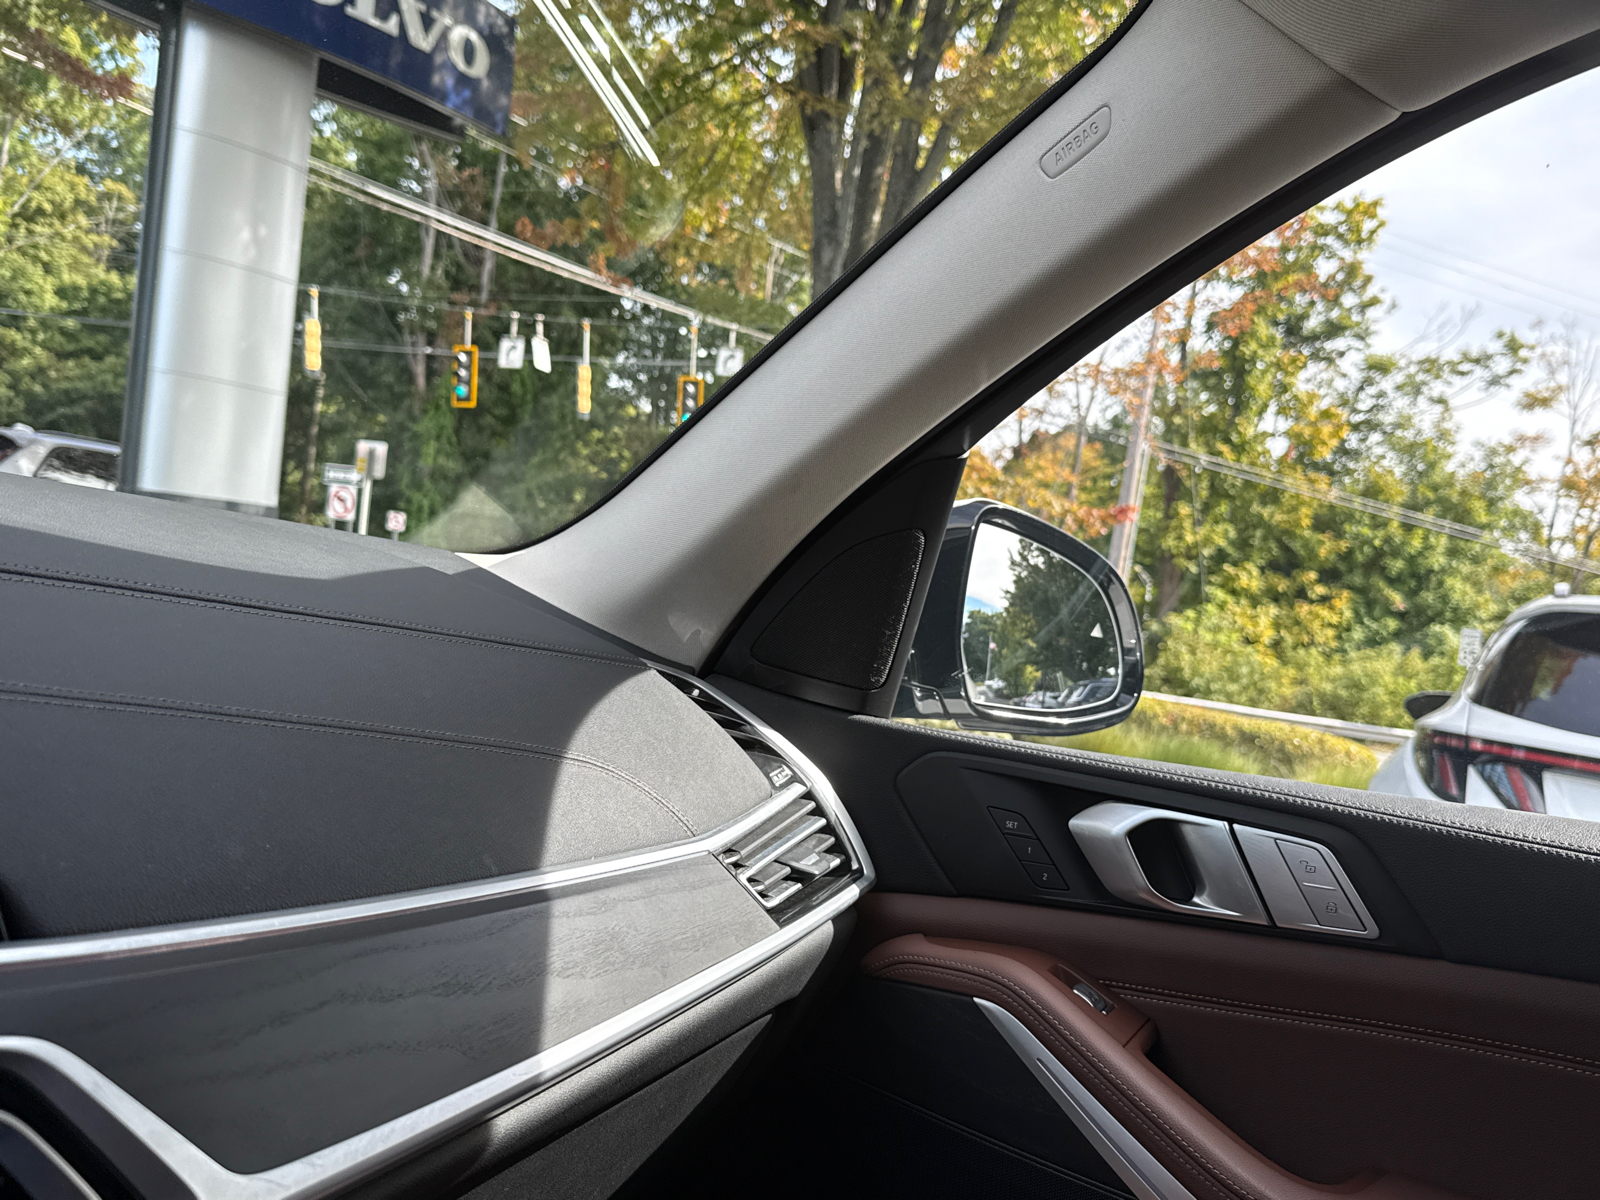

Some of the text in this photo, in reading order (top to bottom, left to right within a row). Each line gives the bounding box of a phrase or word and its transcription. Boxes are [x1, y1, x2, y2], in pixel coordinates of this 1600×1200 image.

[311, 0, 490, 79] LVO
[1055, 121, 1099, 166] AIRBAG
[1005, 820, 1018, 829] SET
[1027, 846, 1032, 854] 1
[1042, 872, 1048, 881] 2
